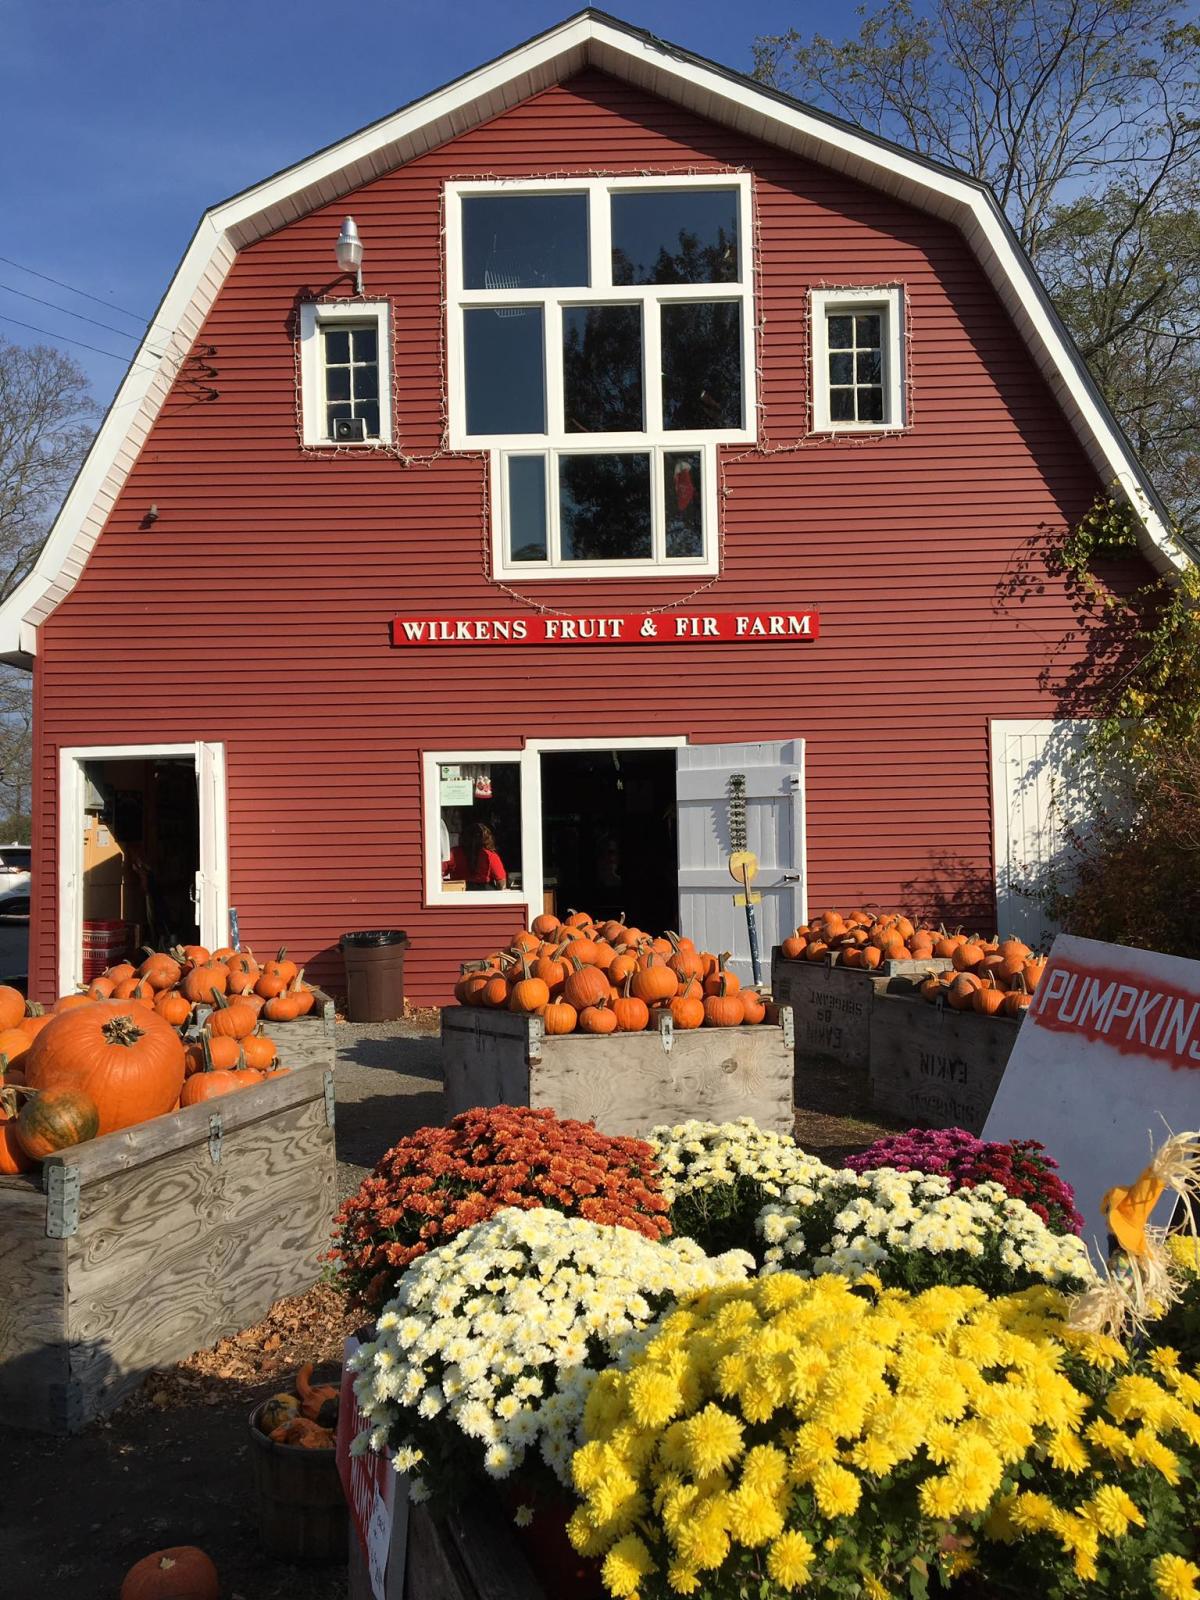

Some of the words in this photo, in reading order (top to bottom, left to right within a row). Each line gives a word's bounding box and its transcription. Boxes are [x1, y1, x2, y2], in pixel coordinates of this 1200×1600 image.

[402, 620, 528, 641] WILKENS
[544, 618, 624, 640] FRUIT
[640, 617, 658, 637] &
[675, 616, 721, 637] FIR
[736, 615, 812, 636] FARM
[920, 1053, 968, 1085] EAKIN
